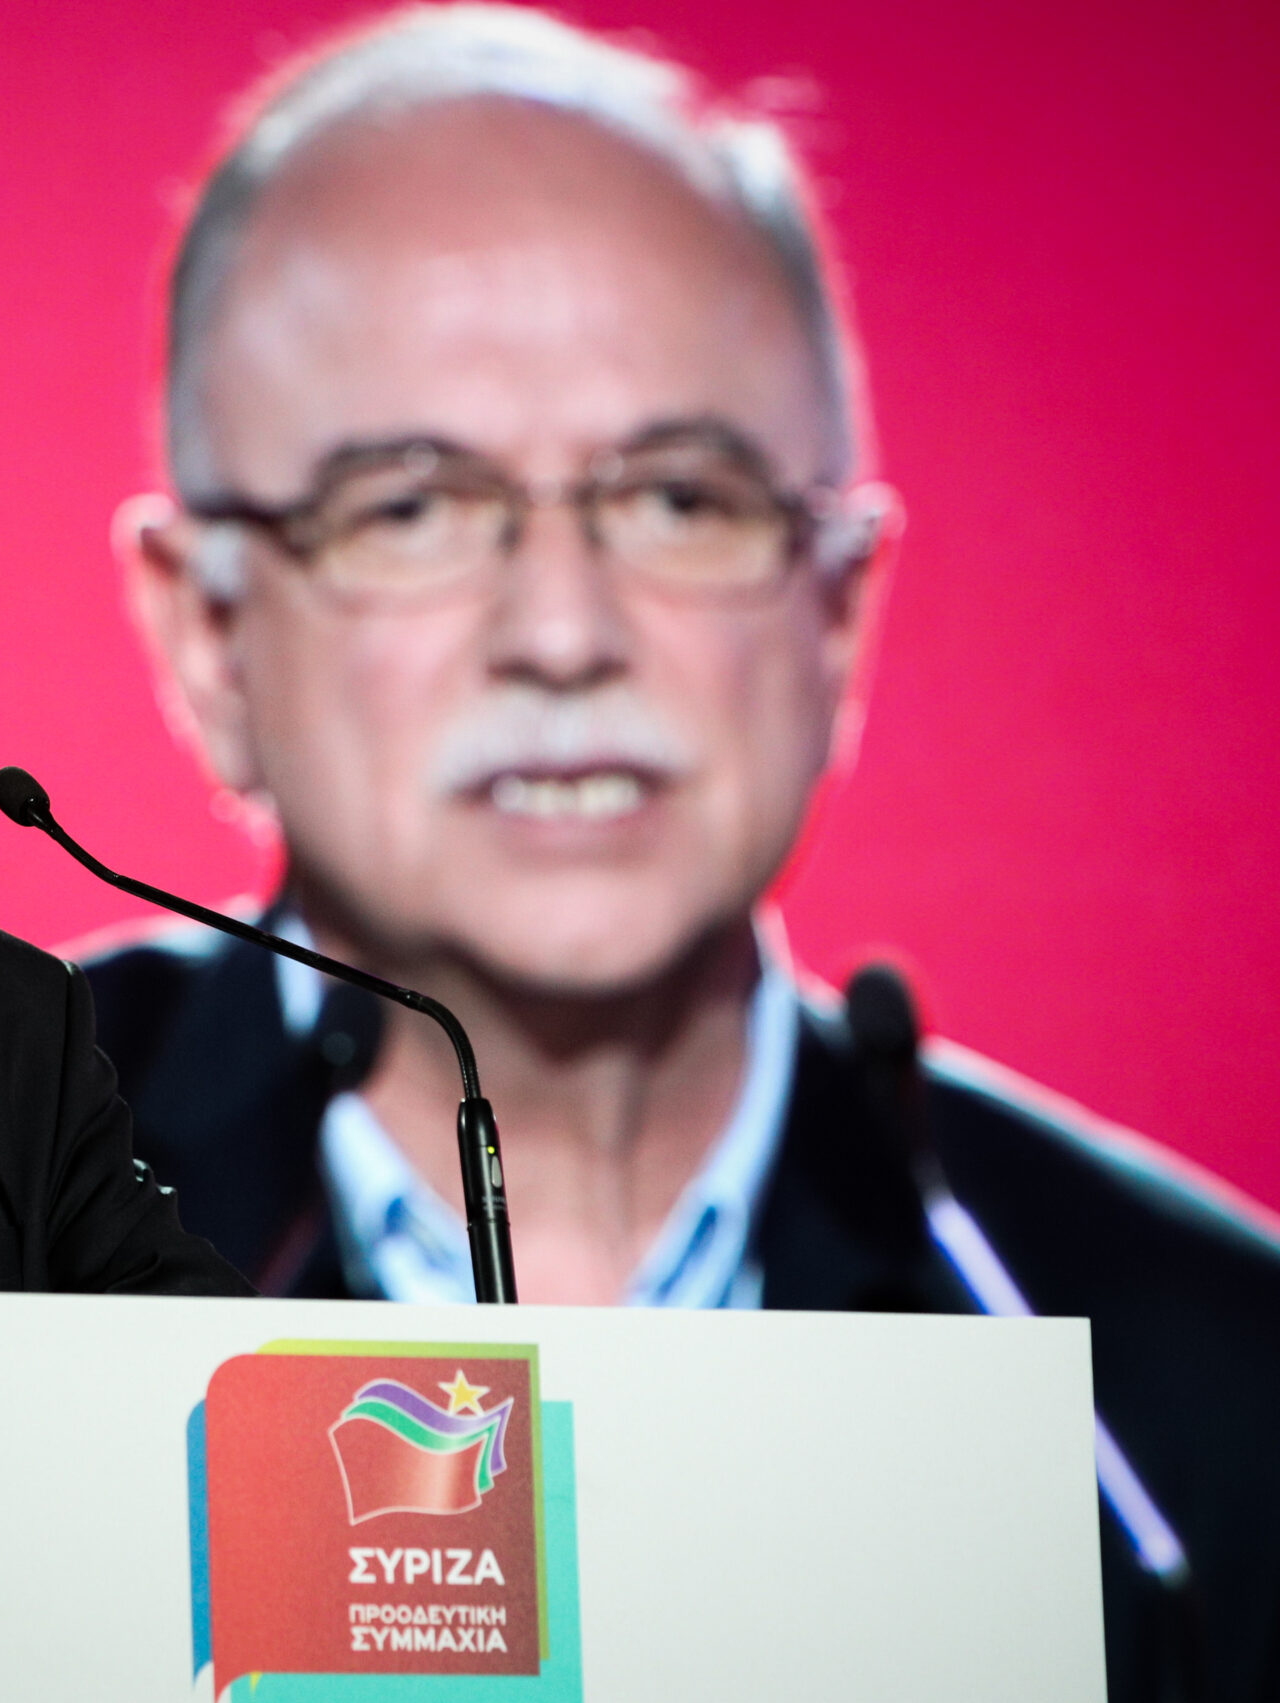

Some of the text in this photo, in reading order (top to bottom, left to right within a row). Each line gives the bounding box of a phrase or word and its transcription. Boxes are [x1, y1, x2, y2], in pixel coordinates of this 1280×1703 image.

[348, 1547, 506, 1585] ΣΥΡΙΖΑ
[349, 1603, 507, 1626] ΠΡΟΟΔΕΥΤΙΚΗ
[350, 1626, 508, 1653] ΣΥΜΜΑΧΙΑ
